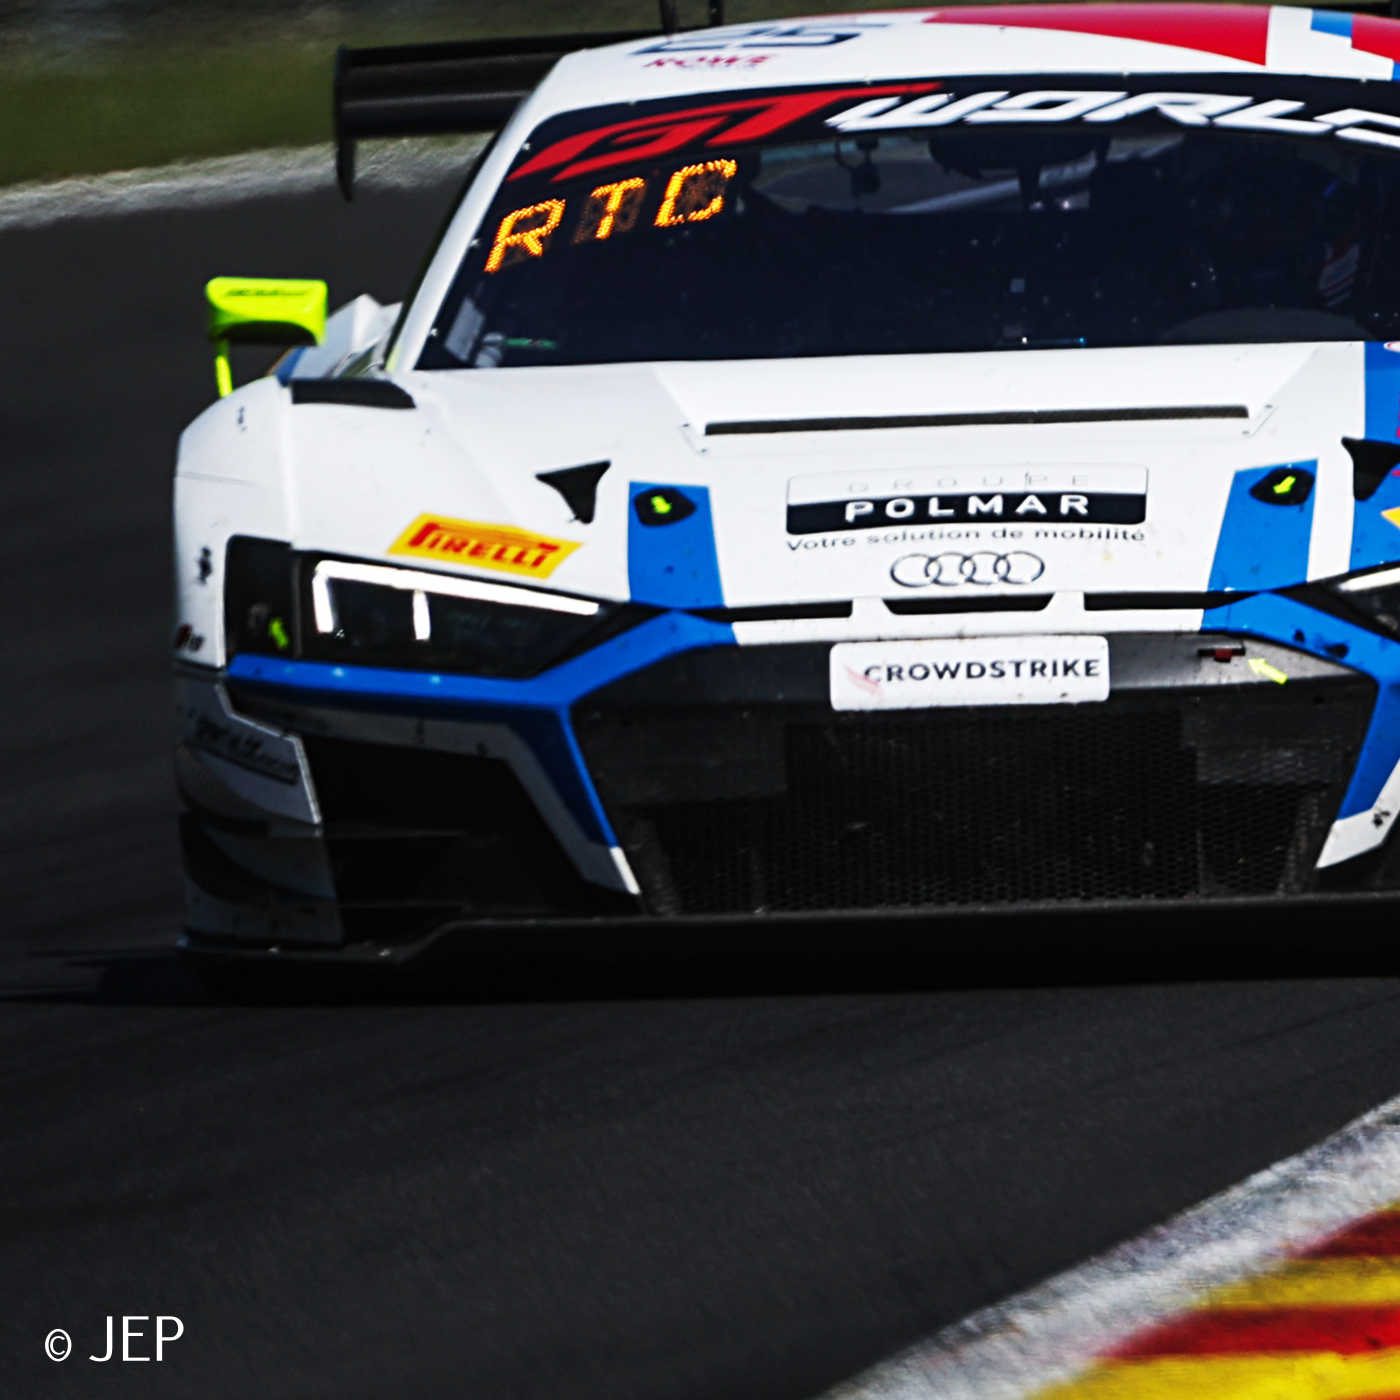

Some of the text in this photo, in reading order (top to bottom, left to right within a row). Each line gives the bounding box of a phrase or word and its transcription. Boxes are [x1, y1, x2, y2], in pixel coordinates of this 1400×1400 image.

[845, 494, 1090, 524] POLMAR
[408, 521, 561, 569] PIRELLI
[786, 526, 1146, 552] Votre solution de mobilité
[864, 658, 1101, 684] CROWDSTRIKE
